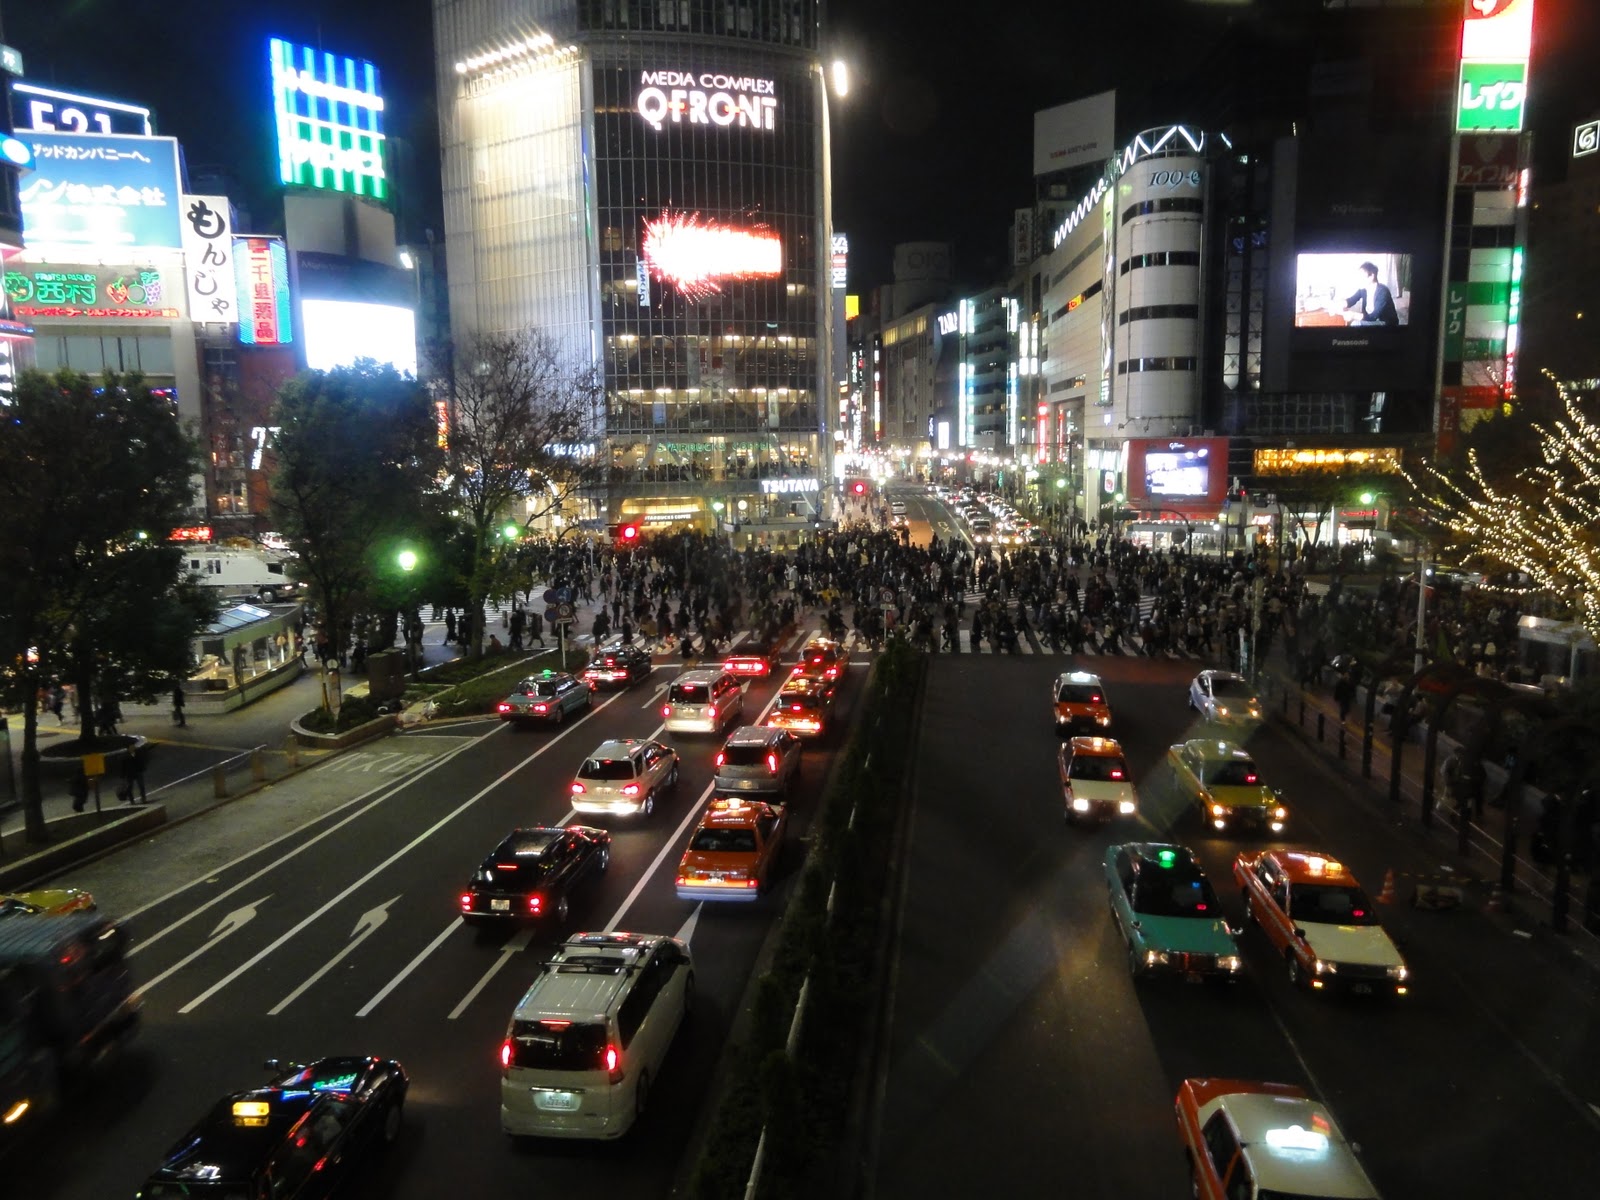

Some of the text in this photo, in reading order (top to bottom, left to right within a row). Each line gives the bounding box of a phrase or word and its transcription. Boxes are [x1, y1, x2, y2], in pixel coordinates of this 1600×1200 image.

[641, 70, 774, 95] MEDIA COMPLEX
[1462, 81, 1528, 110] レイク
[637, 87, 777, 131] QFRONT
[187, 200, 230, 316] もんじゃ
[831, 236, 848, 288] SEIBU
[36, 282, 97, 304] 西村
[1449, 290, 1463, 335] レイク
[657, 442, 725, 452] STARBUCKS
[761, 479, 819, 493] TSUTAYA
